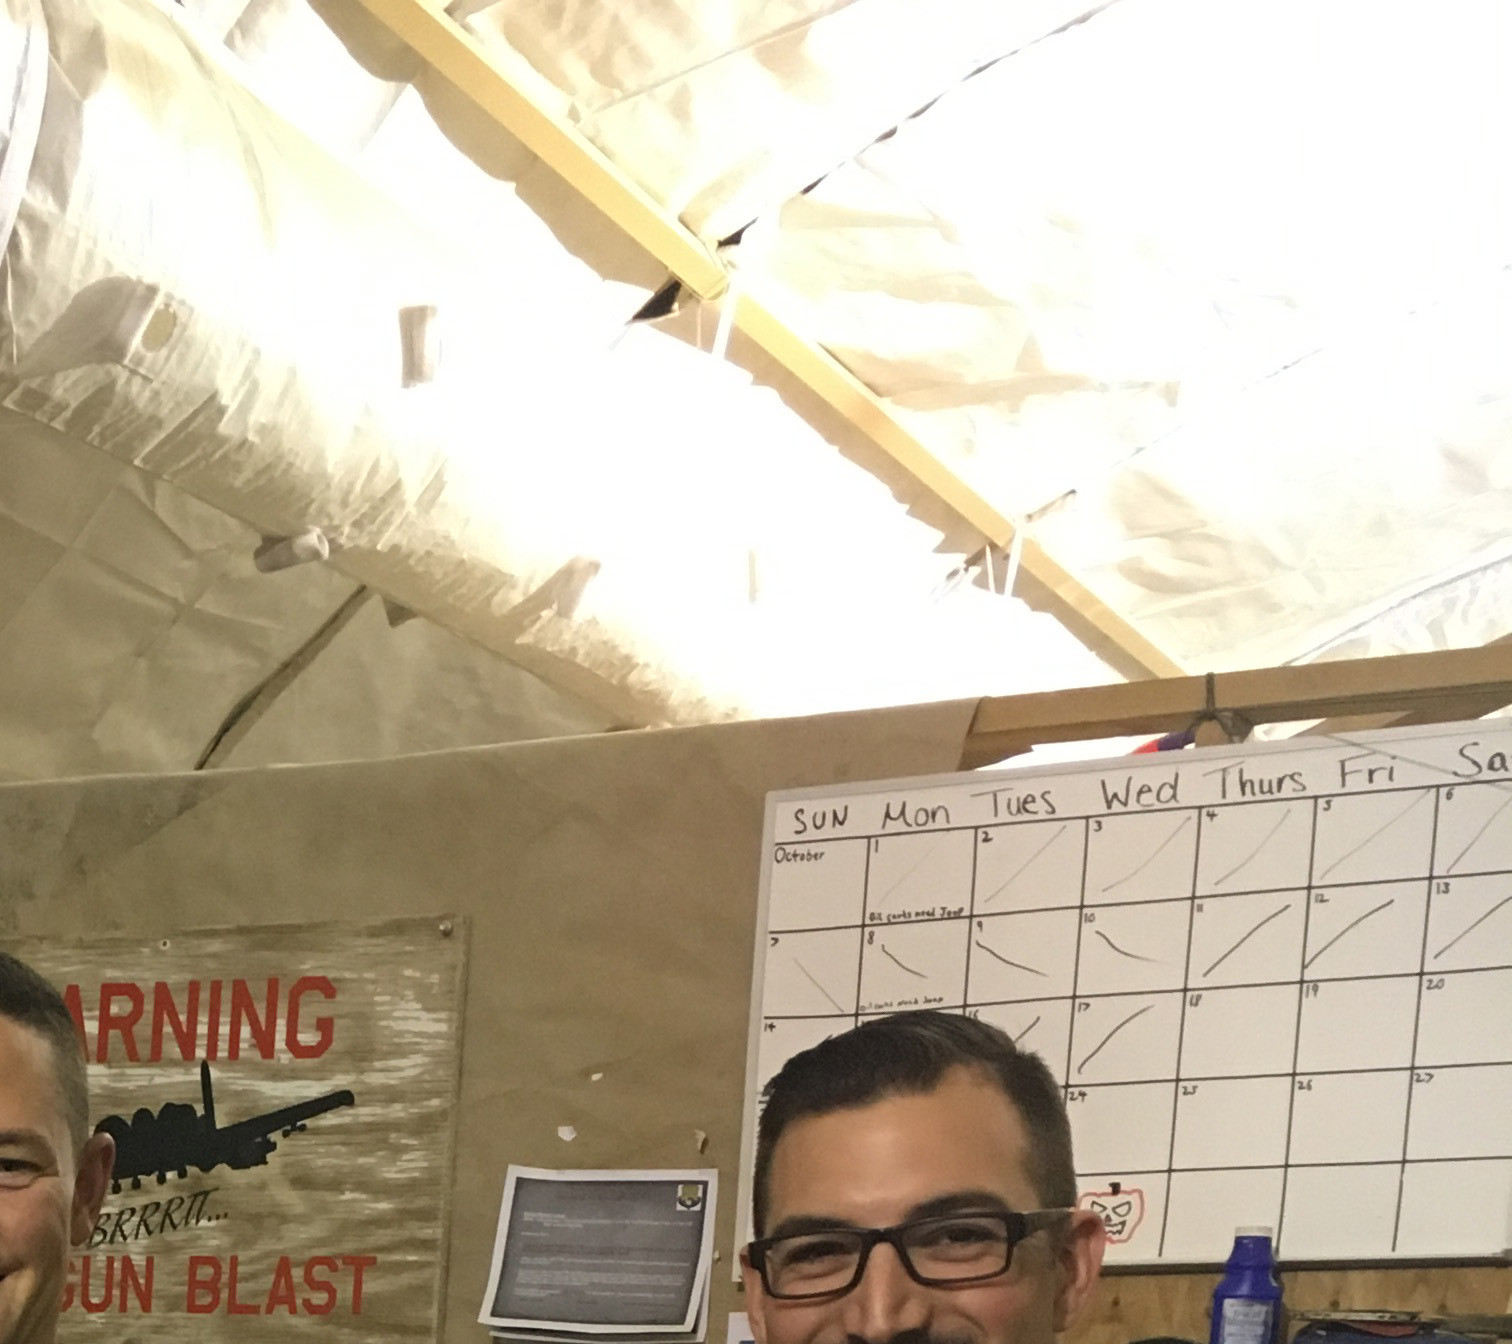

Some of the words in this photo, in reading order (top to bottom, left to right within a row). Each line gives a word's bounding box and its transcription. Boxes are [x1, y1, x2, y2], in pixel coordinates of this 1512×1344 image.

[793, 804, 849, 835] SUN
[881, 800, 951, 831] Mon
[970, 787, 1057, 818] Tues
[1100, 770, 1180, 811] Wed
[1202, 761, 1307, 800] Thurs
[1338, 751, 1398, 788] Fri
[1452, 741, 1512, 778] Sa
[981, 830, 993, 843] 2
[1092, 819, 1103, 832] 3
[1205, 810, 1218, 822] 4
[1322, 799, 1333, 812] 5
[1445, 786, 1455, 800] 6
[774, 845, 826, 864] October
[866, 930, 875, 946] 8
[976, 920, 984, 932] 9
[1083, 912, 1096, 923] 10
[1314, 893, 1330, 904] 12
[1435, 881, 1451, 895] 13
[63, 975, 337, 1064] ARNING
[1189, 993, 1203, 1008] 18
[1305, 983, 1320, 999] 19
[1425, 978, 1445, 991] 20
[1068, 1090, 1088, 1102] 24
[1297, 1080, 1314, 1091] 26
[185, 1254, 378, 1316] BLAST
